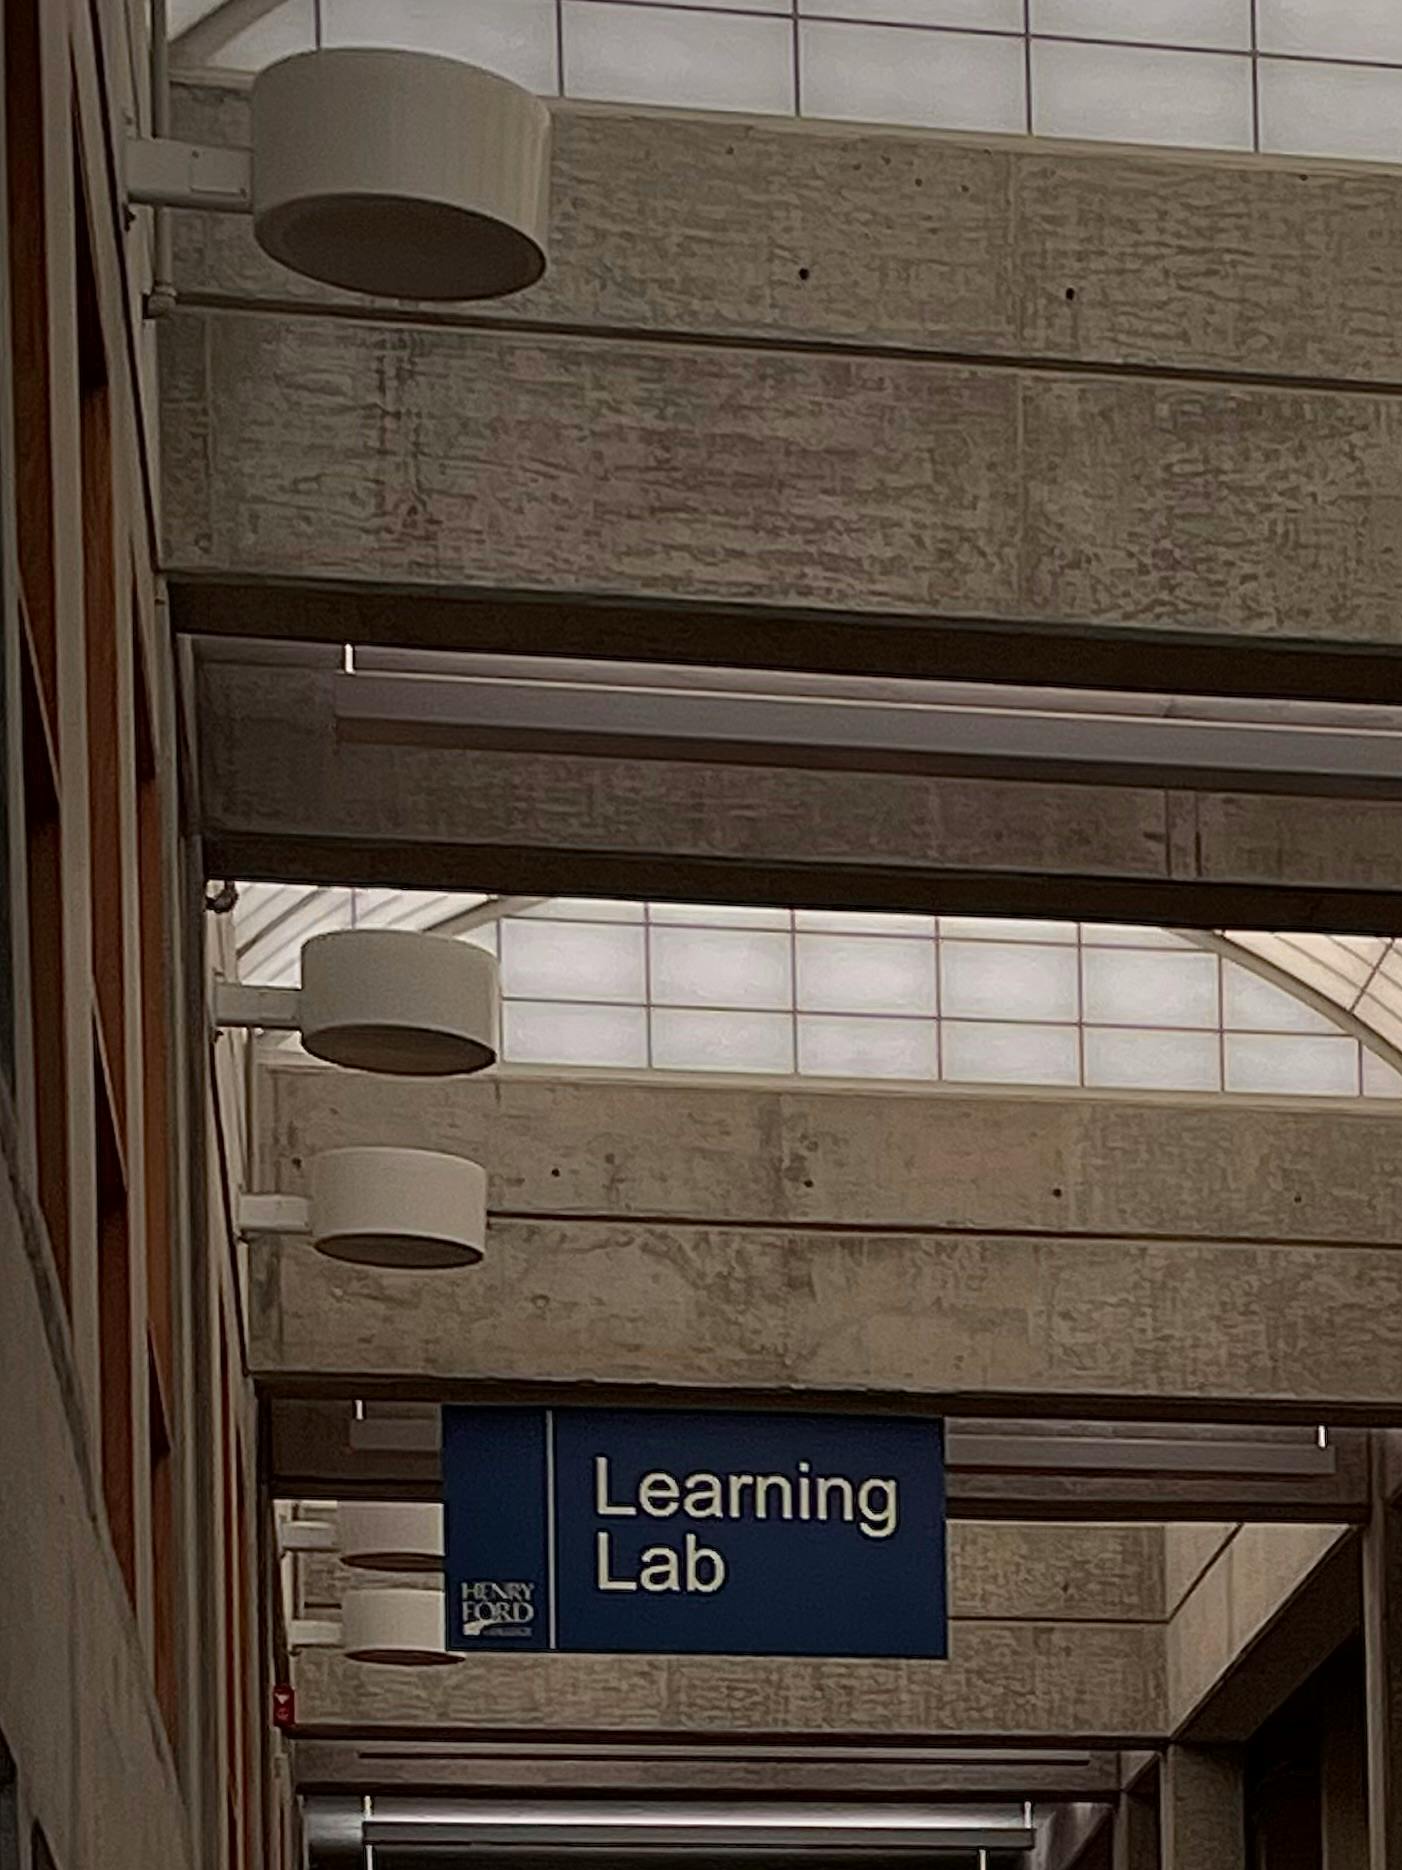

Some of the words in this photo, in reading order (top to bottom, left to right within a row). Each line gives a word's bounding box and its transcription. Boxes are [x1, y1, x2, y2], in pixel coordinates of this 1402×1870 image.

[595, 1455, 898, 1539] Learning
[596, 1530, 727, 1593] Lab
[460, 1581, 536, 1600] HENRY
[461, 1601, 535, 1622] FORD
